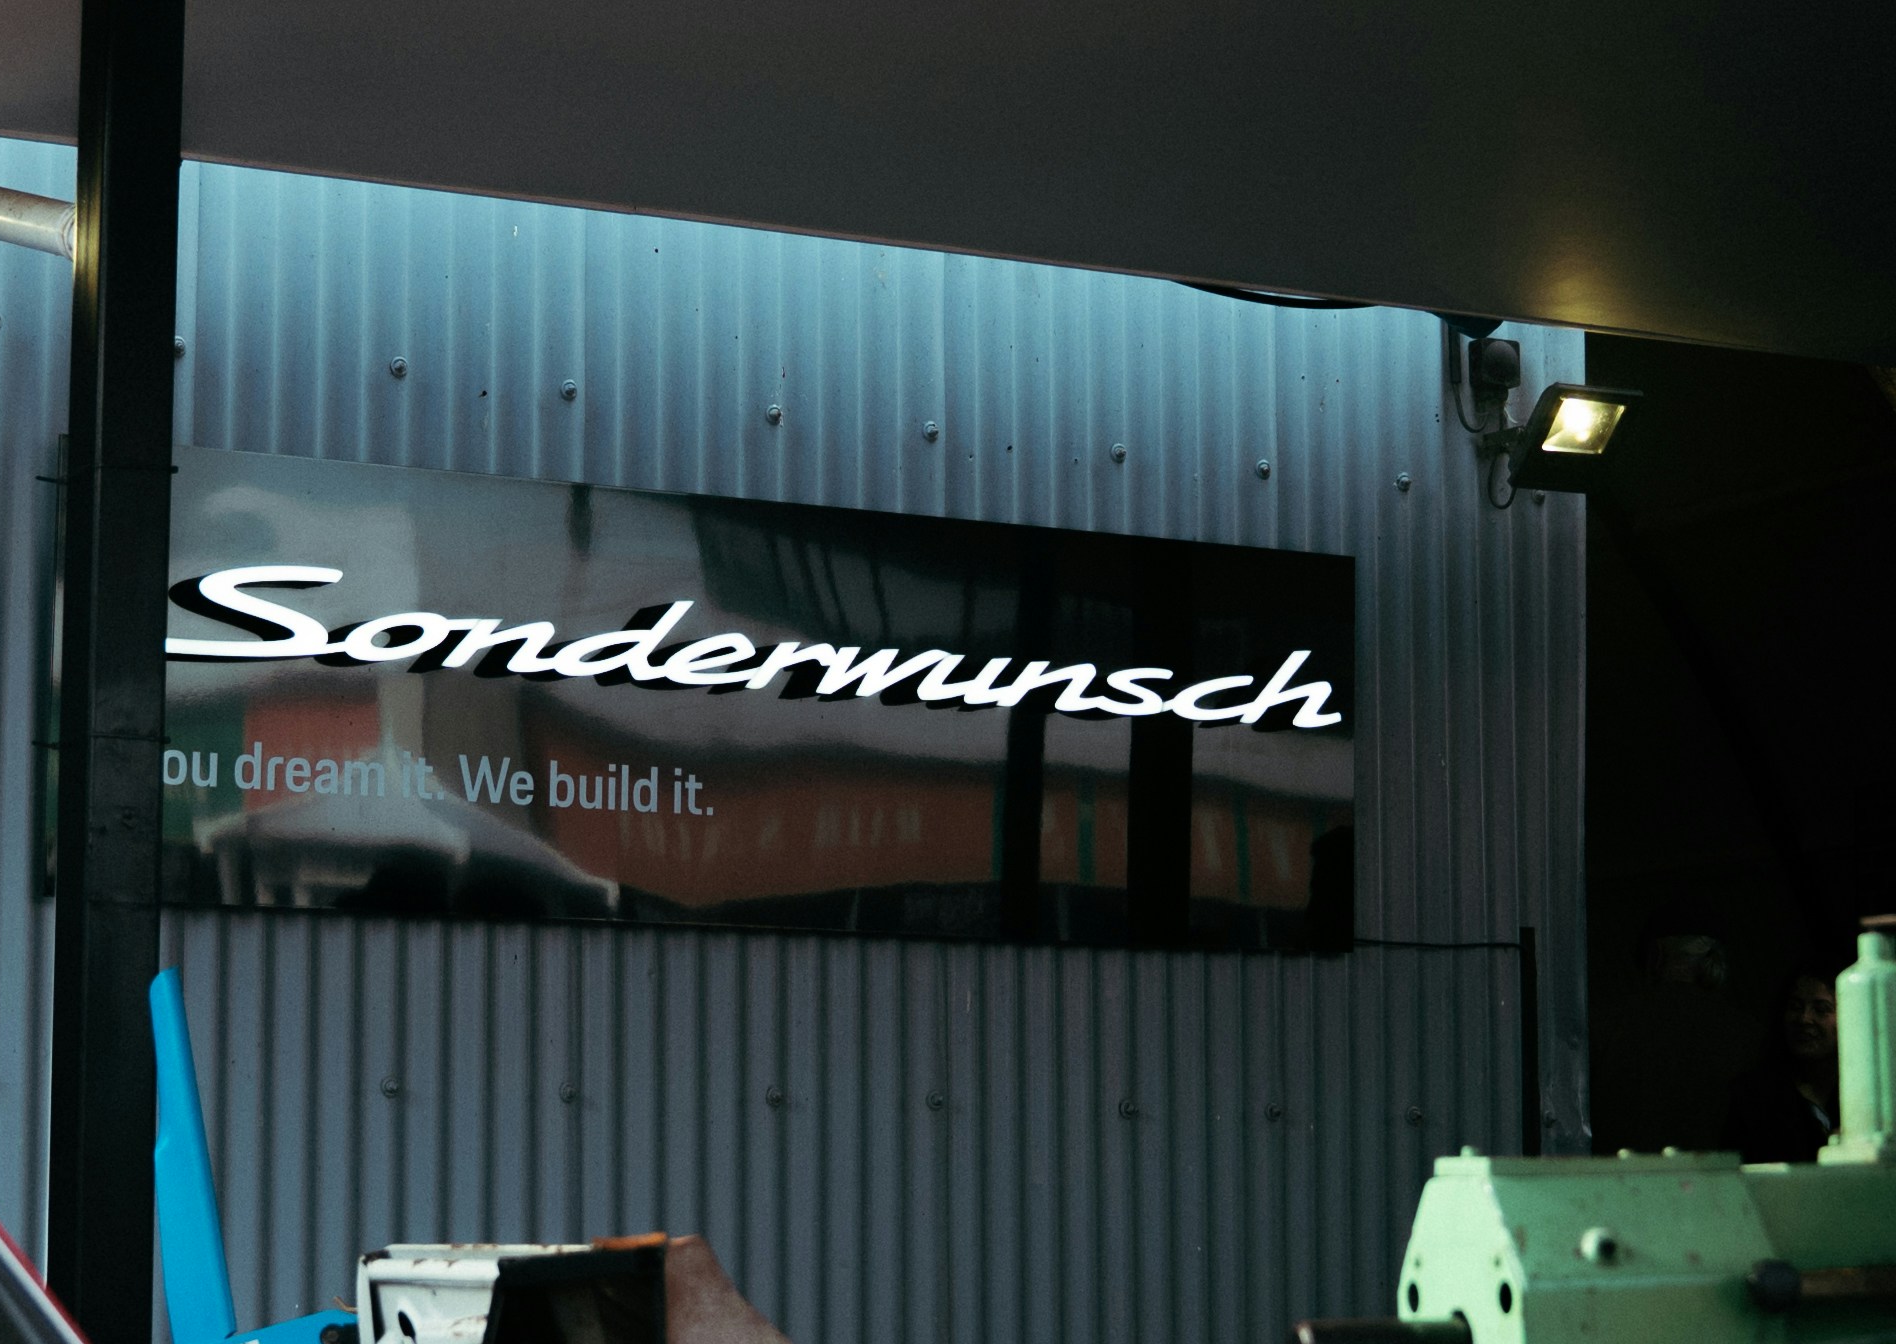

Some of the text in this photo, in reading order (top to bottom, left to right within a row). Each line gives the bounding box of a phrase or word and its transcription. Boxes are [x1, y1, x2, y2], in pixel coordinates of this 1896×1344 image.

[165, 565, 1342, 729] Sonderwunsch
[164, 741, 715, 817] ou dream it. We build it.
